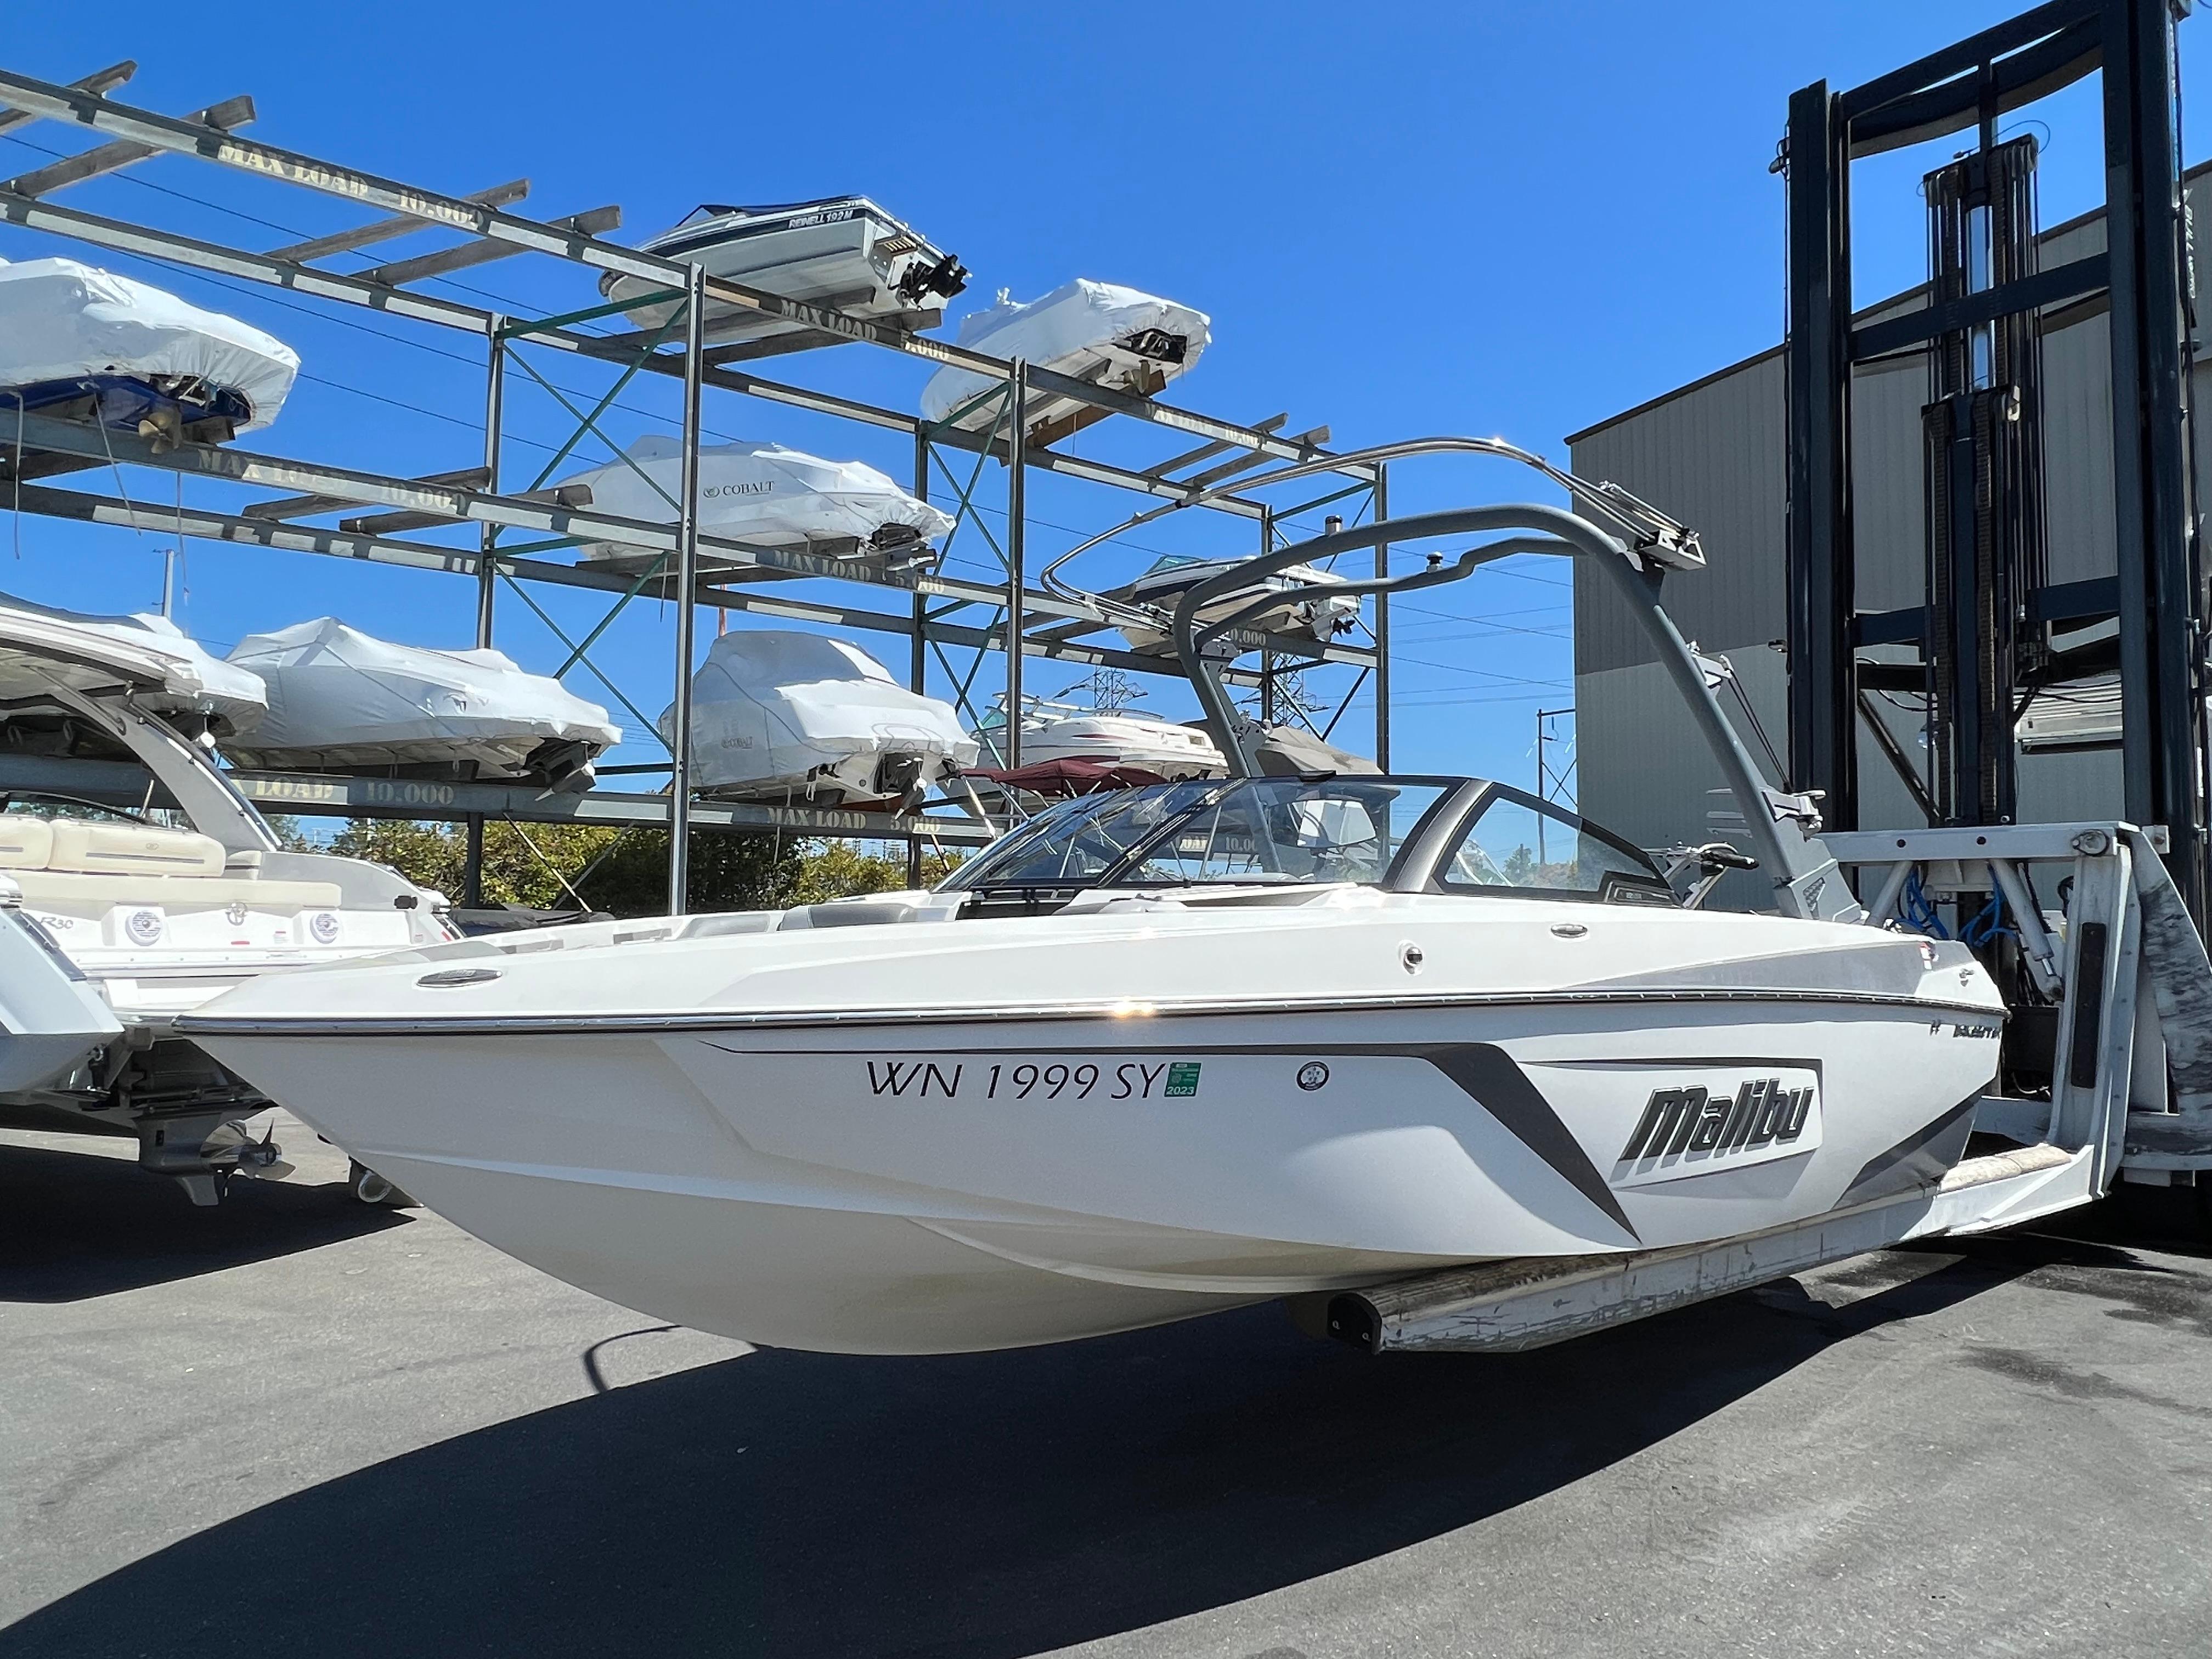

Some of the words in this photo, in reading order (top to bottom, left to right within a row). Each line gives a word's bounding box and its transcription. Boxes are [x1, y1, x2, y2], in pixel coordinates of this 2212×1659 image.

[218, 139, 285, 176] MAX
[294, 160, 369, 196] LOAD
[781, 299, 822, 326] MAX
[828, 313, 877, 340] LOAD
[723, 481, 776, 496] COBALT
[774, 550, 816, 573] MAX
[822, 559, 872, 582] LOAD
[255, 775, 334, 799] LOAD
[768, 808, 810, 826] MAX
[815, 811, 867, 830] LOAD
[41, 916, 74, 929] R30
[867, 1060, 963, 1098] WN
[988, 1064, 1099, 1099] 1999
[1110, 1062, 1166, 1099] SY
[1166, 1086, 1194, 1095] 2023
[1613, 1077, 1815, 1171] Malibu
